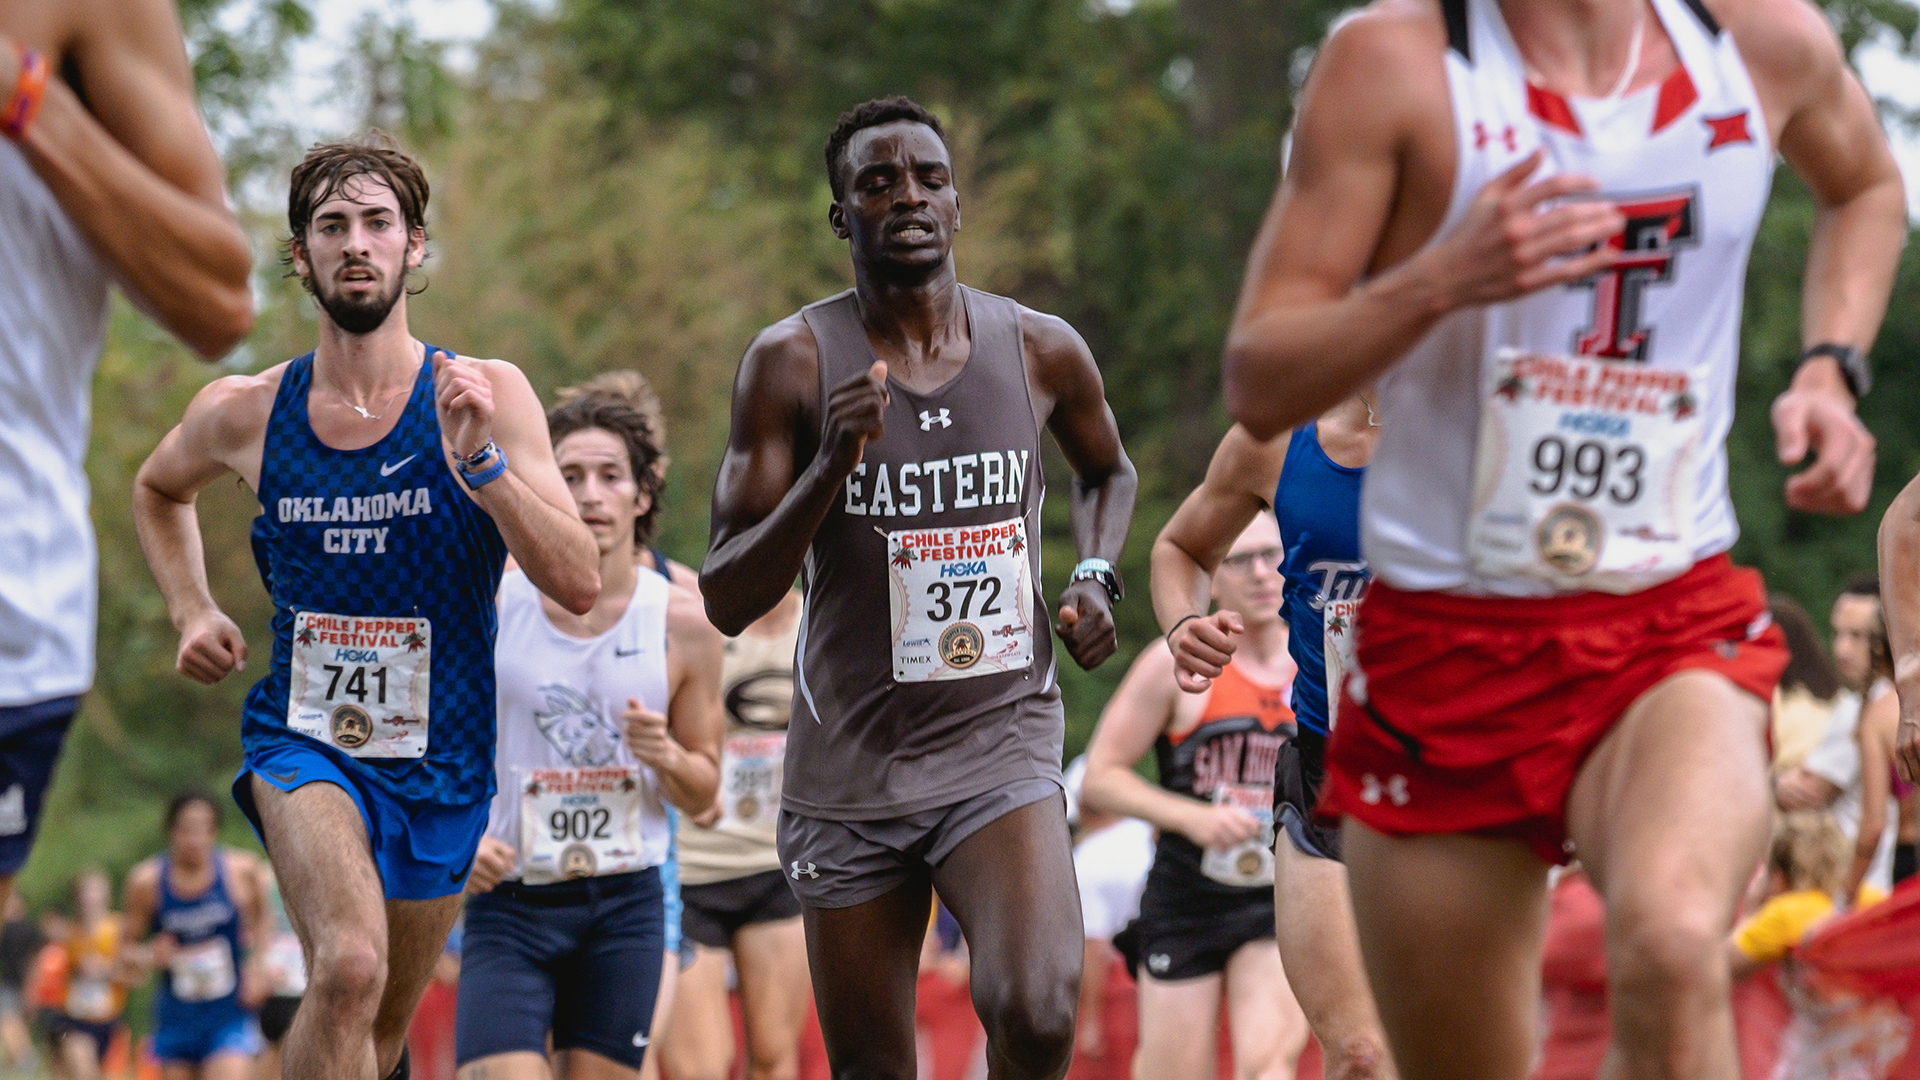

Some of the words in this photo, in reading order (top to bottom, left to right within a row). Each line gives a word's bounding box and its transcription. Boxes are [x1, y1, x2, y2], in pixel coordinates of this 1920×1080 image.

[845, 450, 1028, 517] EASTERN
[1528, 435, 1647, 506] 993
[278, 487, 432, 523] OKLAHOMA
[323, 527, 389, 554] CITY
[901, 533, 954, 549] CHILE
[960, 523, 1017, 545] PEPPER
[920, 542, 1005, 562] FESTIVAL
[940, 560, 988, 578] HOKA
[926, 576, 1002, 622] 372
[306, 616, 349, 632] CHILE
[355, 620, 417, 635] PEPPER
[319, 631, 399, 648] FESTIVAL
[335, 648, 379, 664] HOKA
[900, 655, 932, 665] TIMEX
[323, 664, 387, 704] 741
[550, 808, 611, 842] 902
